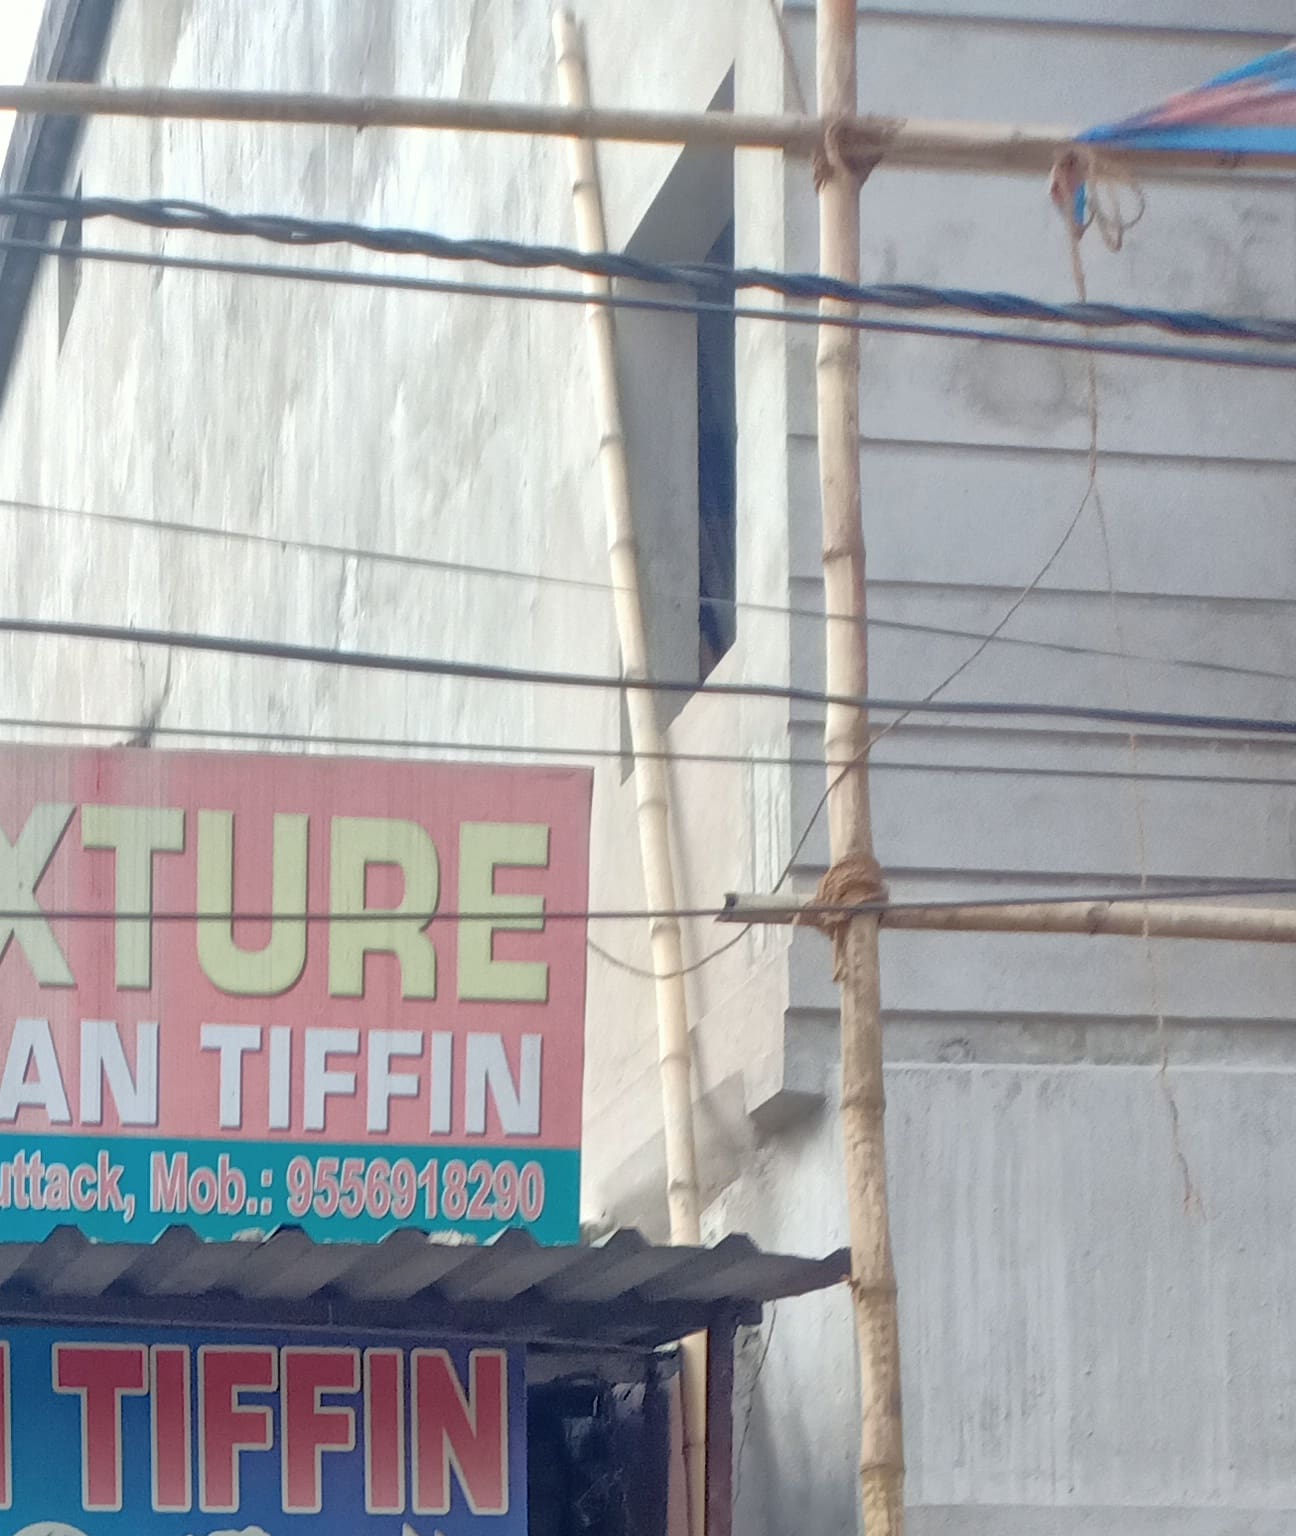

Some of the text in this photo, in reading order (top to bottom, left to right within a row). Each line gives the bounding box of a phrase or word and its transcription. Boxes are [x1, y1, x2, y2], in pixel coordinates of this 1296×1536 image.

[200, 1024, 543, 1136] TIFFIN
[149, 1152, 274, 1217] Mob.:
[285, 1158, 544, 1224] 9556918290
[52, 1341, 508, 1516] TIFFIN
